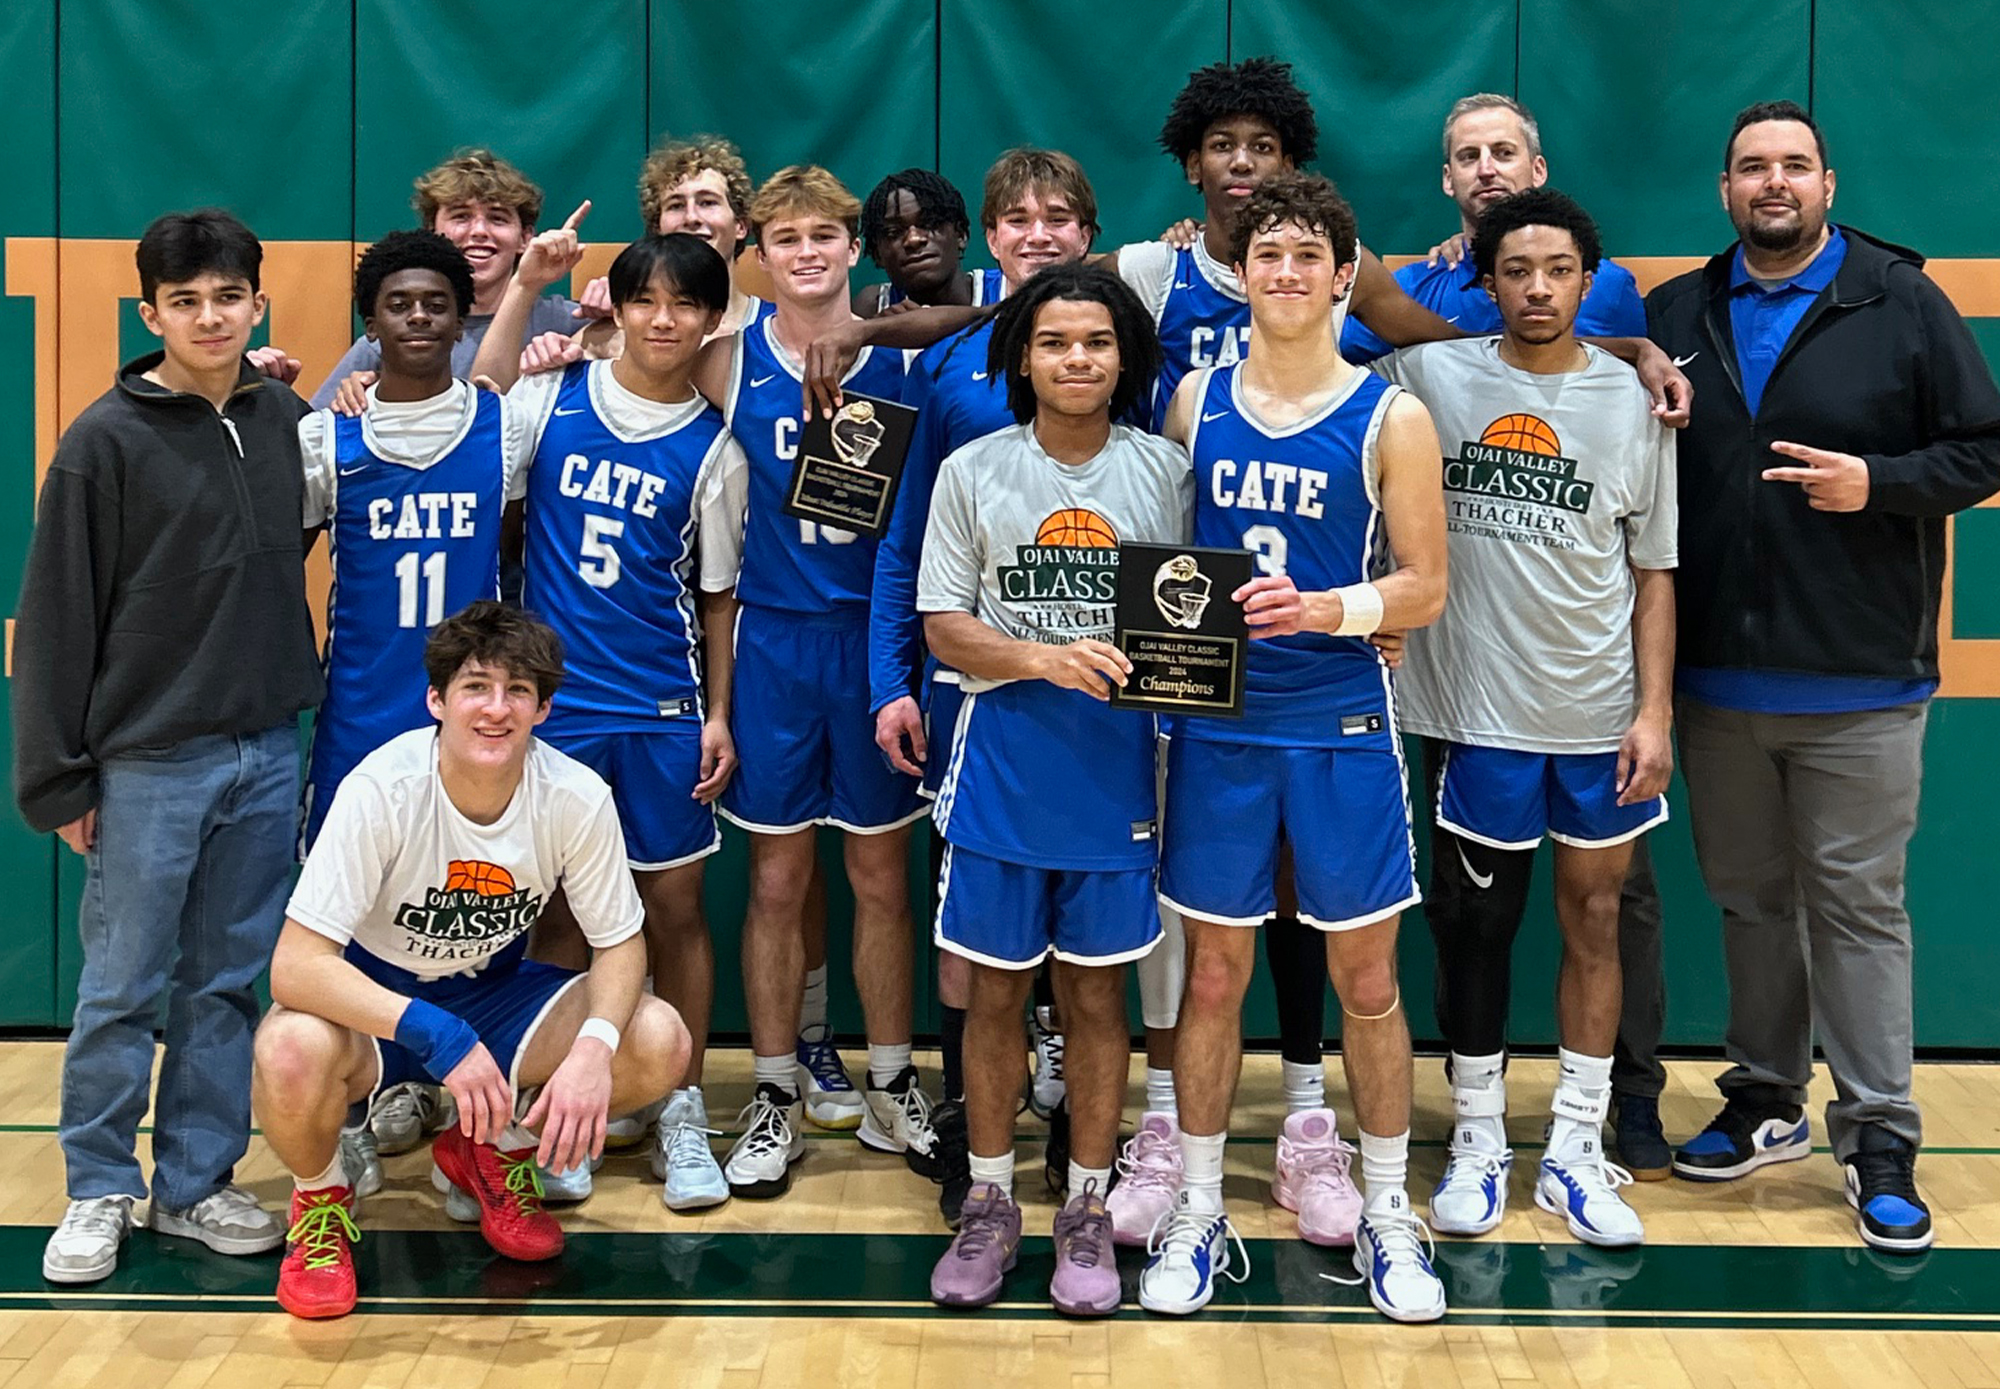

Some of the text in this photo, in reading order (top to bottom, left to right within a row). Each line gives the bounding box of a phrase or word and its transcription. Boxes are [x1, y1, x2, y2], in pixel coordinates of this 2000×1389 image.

[1189, 326, 1250, 368] CA
[1466, 445, 1571, 475] OJAI VALLEY
[560, 453, 667, 519] CATE
[1211, 459, 1328, 519] CATE
[1444, 462, 1588, 510] CLASSIC
[367, 492, 477, 540] CATE
[1452, 500, 1566, 534] THACHER
[578, 513, 625, 589] 5
[1447, 521, 1575, 551] LL-TOURNAMENT TEAM
[1023, 548, 1120, 566] OJAI VALLE
[395, 551, 447, 628] 11
[1004, 568, 1115, 601] CLASS
[1017, 607, 1109, 629] THACH
[1128, 651, 1230, 668] BASKETBALL TOURNAMENT
[1140, 641, 1220, 656] OJAI VALLEY CLASSIC
[1139, 675, 1215, 699] Champions
[1168, 666, 1187, 676] 2024
[402, 900, 538, 938] CLASSIC
[406, 936, 505, 959] THACH
